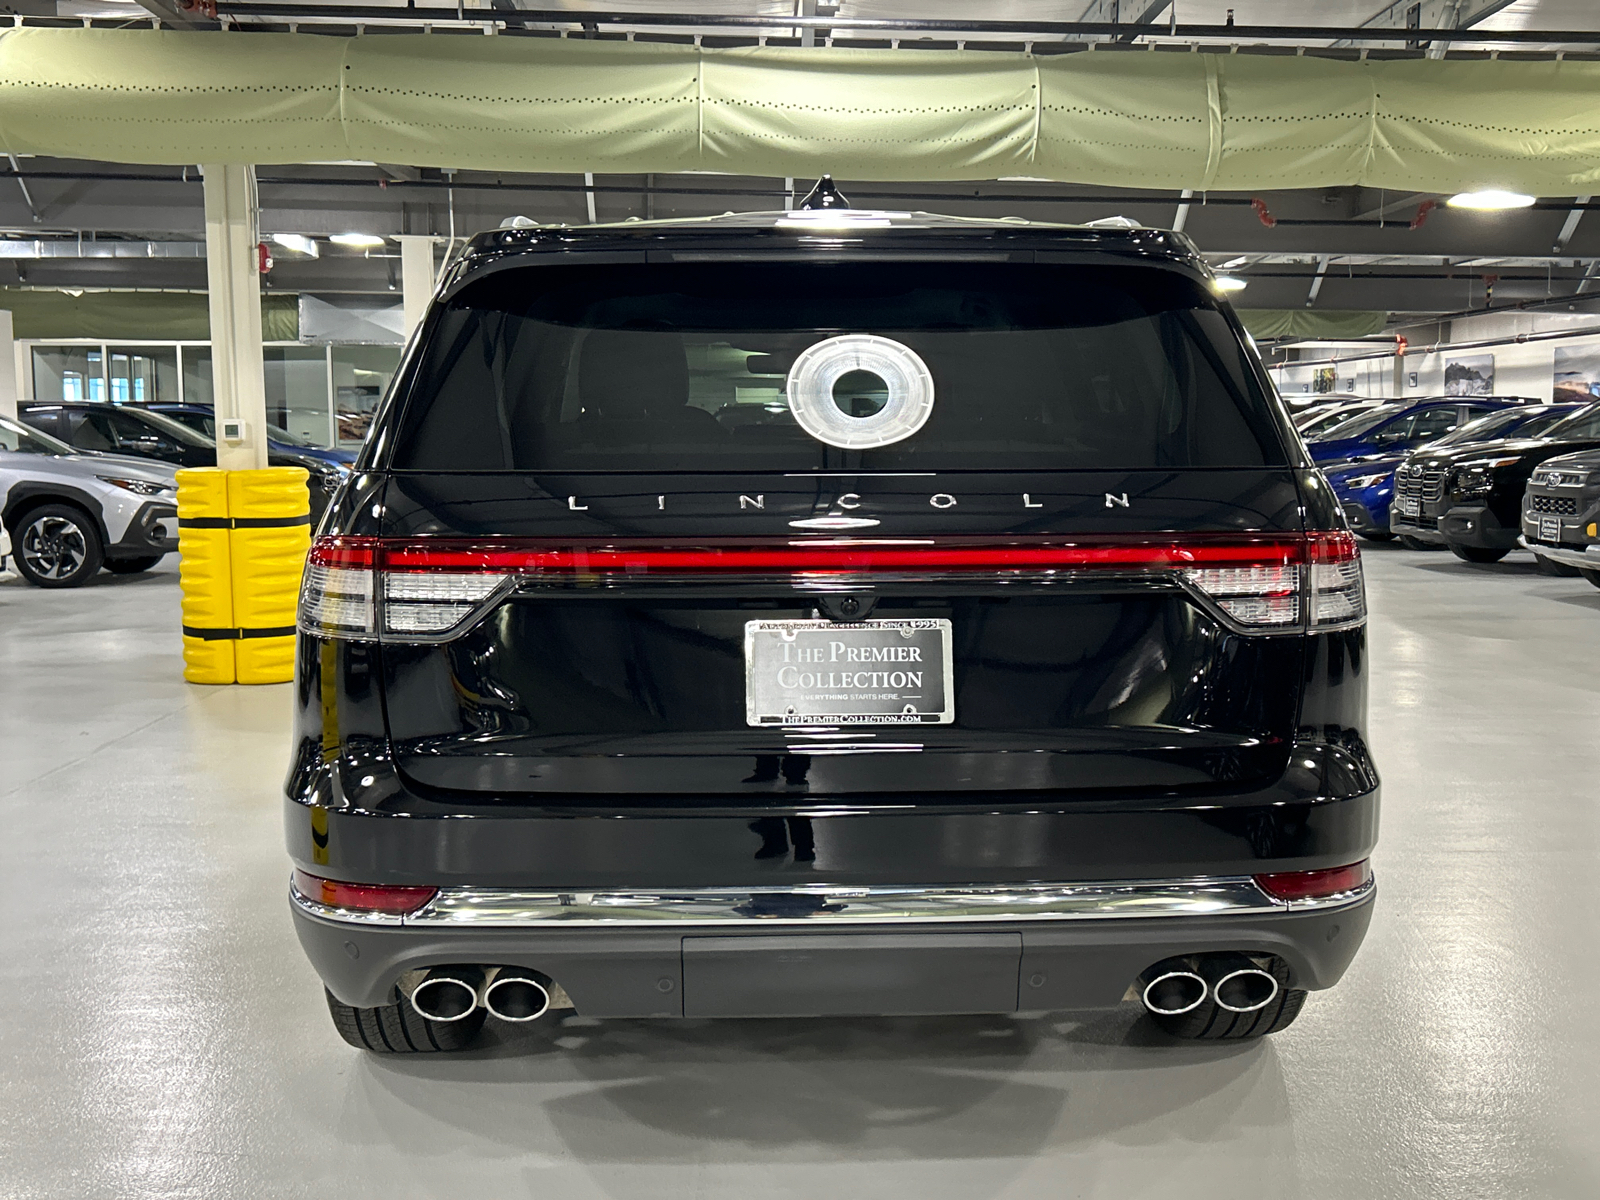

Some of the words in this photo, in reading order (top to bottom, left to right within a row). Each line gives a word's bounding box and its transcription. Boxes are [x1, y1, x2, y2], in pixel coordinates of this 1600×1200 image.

[567, 492, 1130, 511] LINCOLN
[882, 621, 908, 629] SINCE
[911, 620, 938, 629] 1995
[777, 642, 825, 663] THE
[829, 641, 923, 662] PREMIER
[777, 665, 924, 689] COLLECTION
[800, 693, 848, 701] EVERYTHING
[849, 693, 877, 701] STARTS
